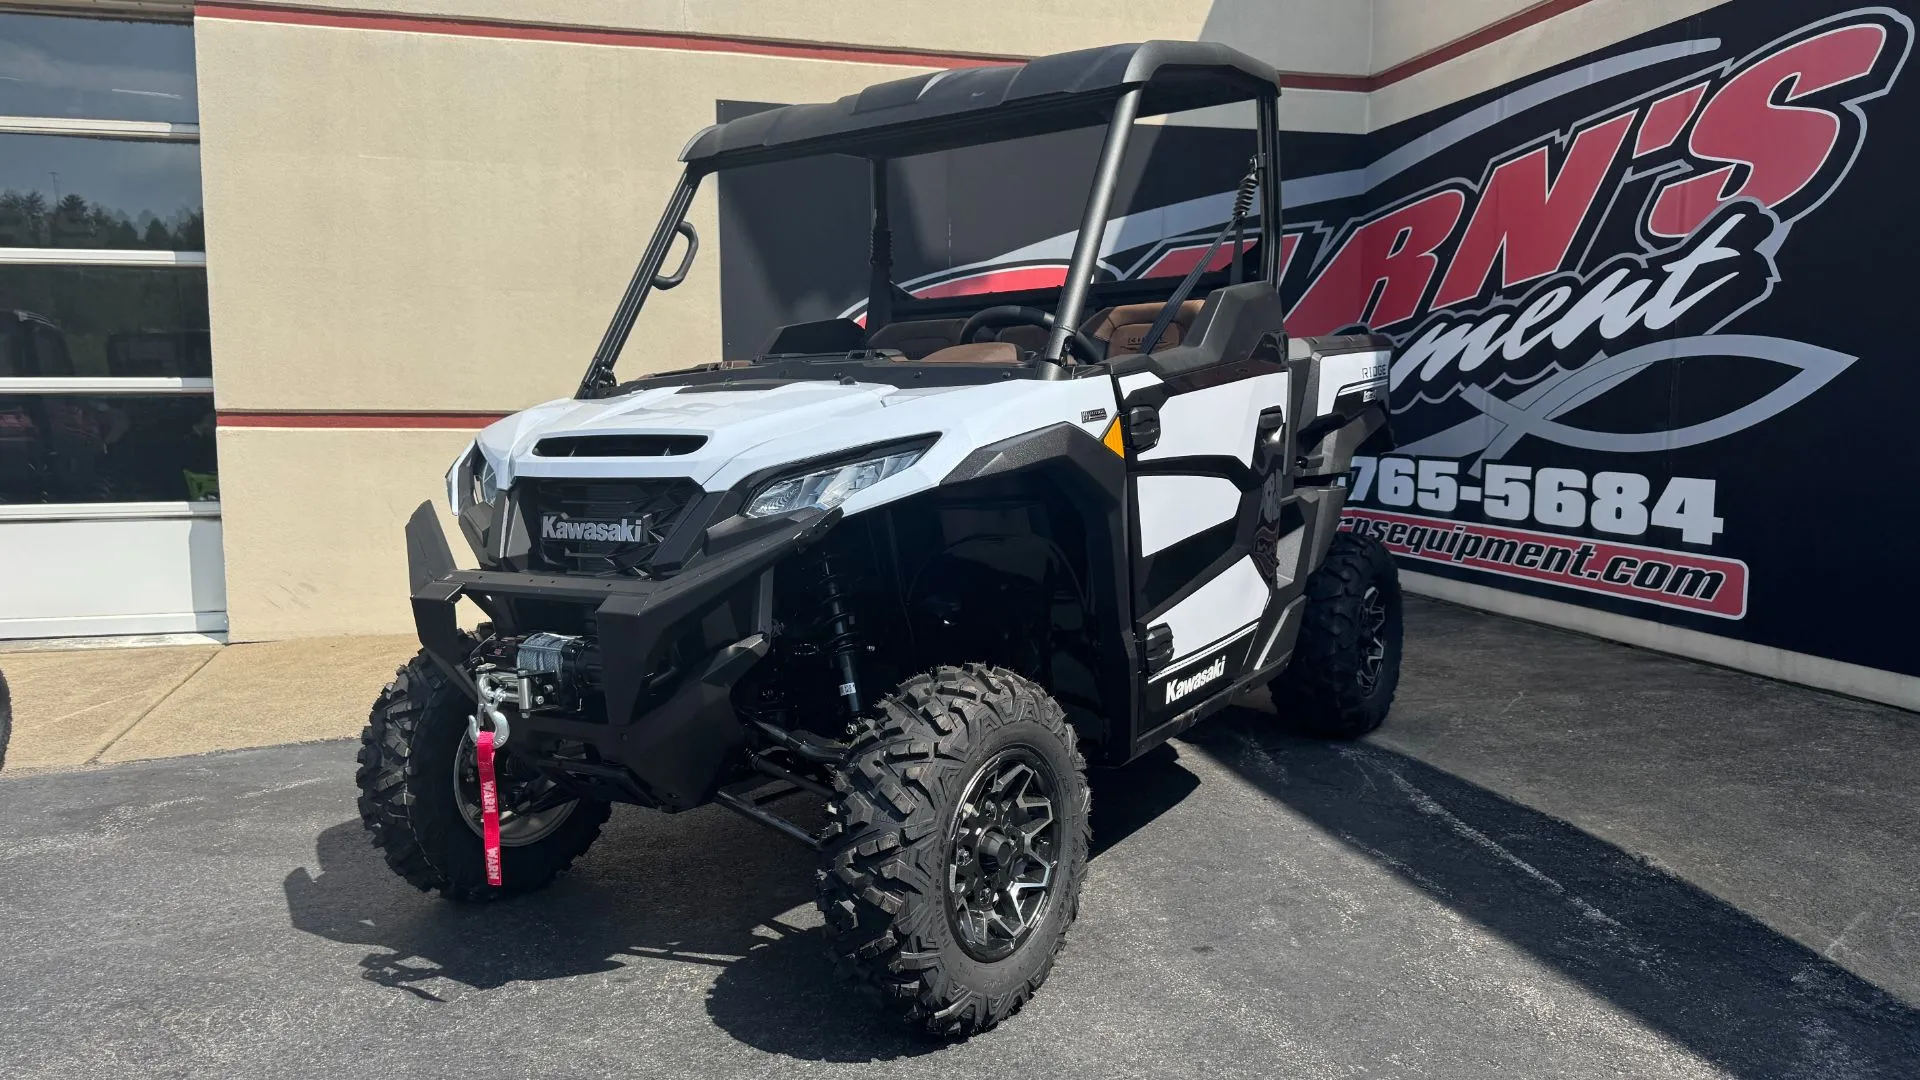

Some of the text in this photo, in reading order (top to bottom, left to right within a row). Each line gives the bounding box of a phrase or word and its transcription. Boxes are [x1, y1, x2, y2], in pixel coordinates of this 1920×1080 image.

[1140, 22, 1887, 340] RN'S
[1361, 364, 1387, 379] RIDGE
[541, 515, 642, 542] Kawasaki
[1165, 655, 1227, 705] Kawasaki
[483, 780, 496, 813] WARN
[486, 846, 500, 880] WARN
